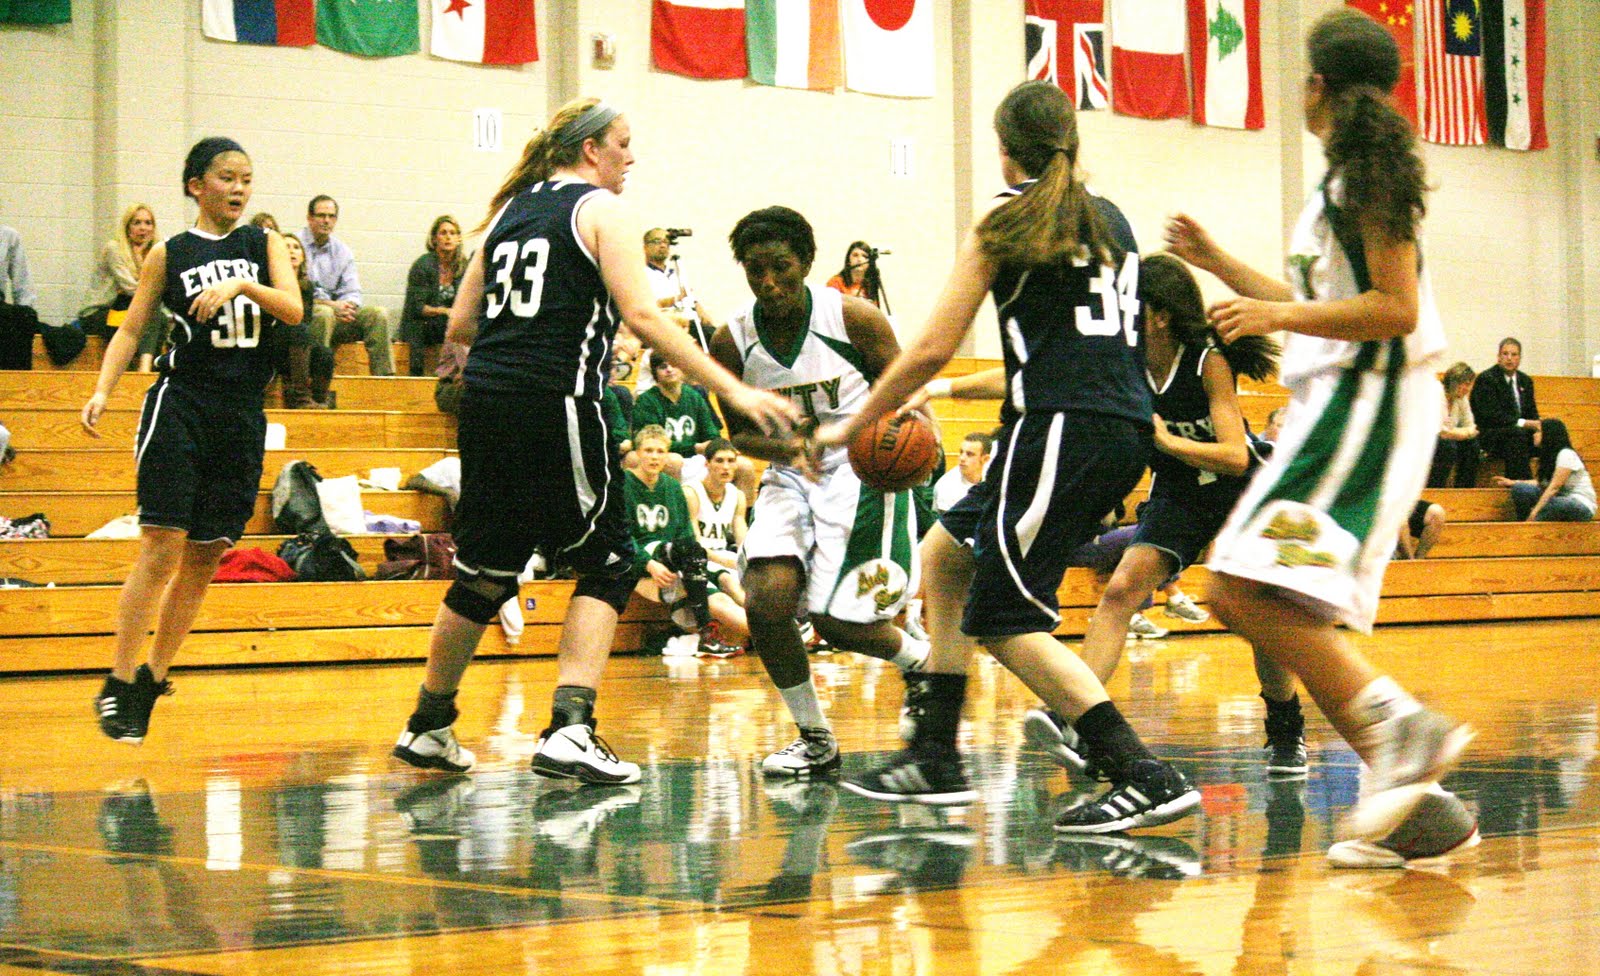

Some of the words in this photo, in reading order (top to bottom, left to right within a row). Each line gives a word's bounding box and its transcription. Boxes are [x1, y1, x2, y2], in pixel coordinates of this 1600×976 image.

[476, 114, 497, 148] 10
[486, 238, 550, 318] 33
[1073, 245, 1140, 346] 34
[211, 294, 260, 348] 30
[778, 376, 841, 415] TY
